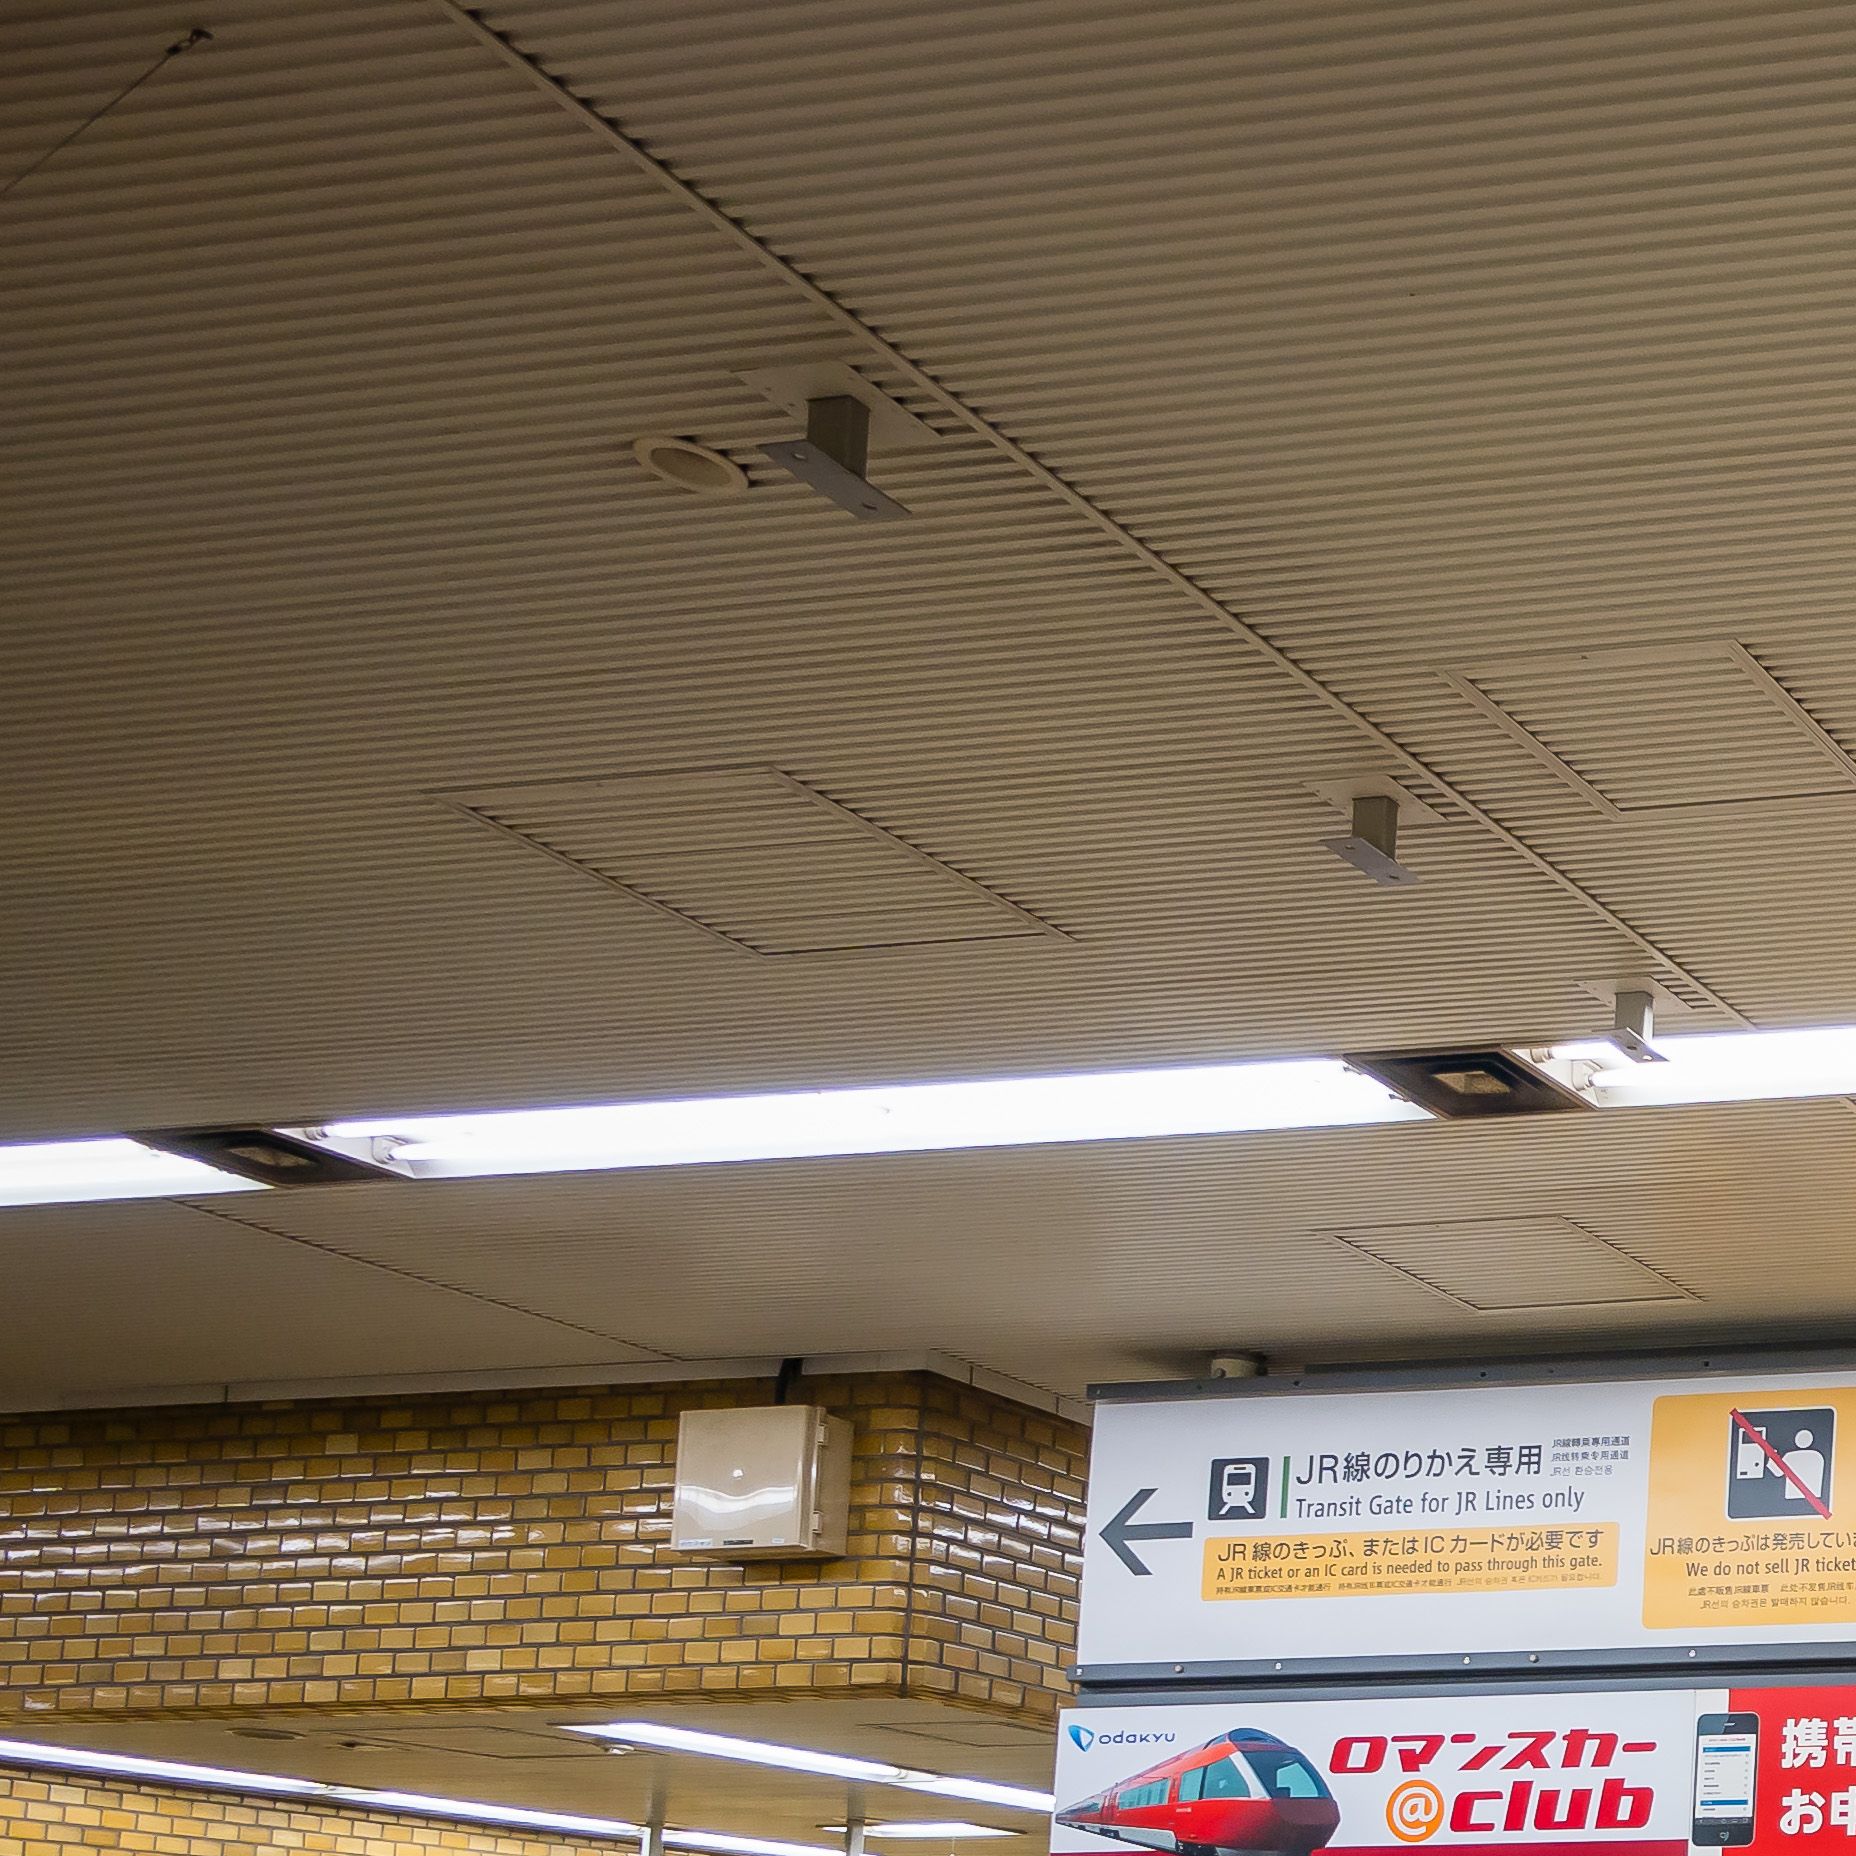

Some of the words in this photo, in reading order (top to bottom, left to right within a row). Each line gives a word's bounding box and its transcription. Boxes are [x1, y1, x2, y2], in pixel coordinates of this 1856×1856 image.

[1296, 1444, 1543, 1486] JR線のりかえ専用
[1296, 1495, 1362, 1519] Transit
[1369, 1493, 1414, 1516] Gate
[1421, 1491, 1448, 1513] for
[1455, 1491, 1477, 1516] JR
[1485, 1488, 1536, 1511] Lines
[1542, 1486, 1586, 1512] only
[1216, 1568, 1226, 1581] A
[1230, 1567, 1244, 1582] JR
[1248, 1566, 1283, 1580] ticket
[1287, 1567, 1300, 1578] or
[1304, 1567, 1320, 1578] an
[1325, 1564, 1337, 1577] IC
[1341, 1563, 1368, 1576] card
[1372, 1563, 1382, 1575] is
[1387, 1560, 1432, 1574] needed
[1437, 1561, 1450, 1572] to
[1454, 1561, 1483, 1576] pass
[1487, 1557, 1538, 1573] through
[1542, 1555, 1565, 1568] this
[1569, 1554, 1602, 1569] gate.
[1686, 1561, 1709, 1577] We
[1713, 1561, 1731, 1576] do
[1736, 1560, 1760, 1576] not
[1764, 1558, 1789, 1574] sell
[1794, 1558, 1810, 1575] JR
[1329, 1727, 1657, 1774] ロマンスカー
[1385, 1777, 1655, 1844] @club
